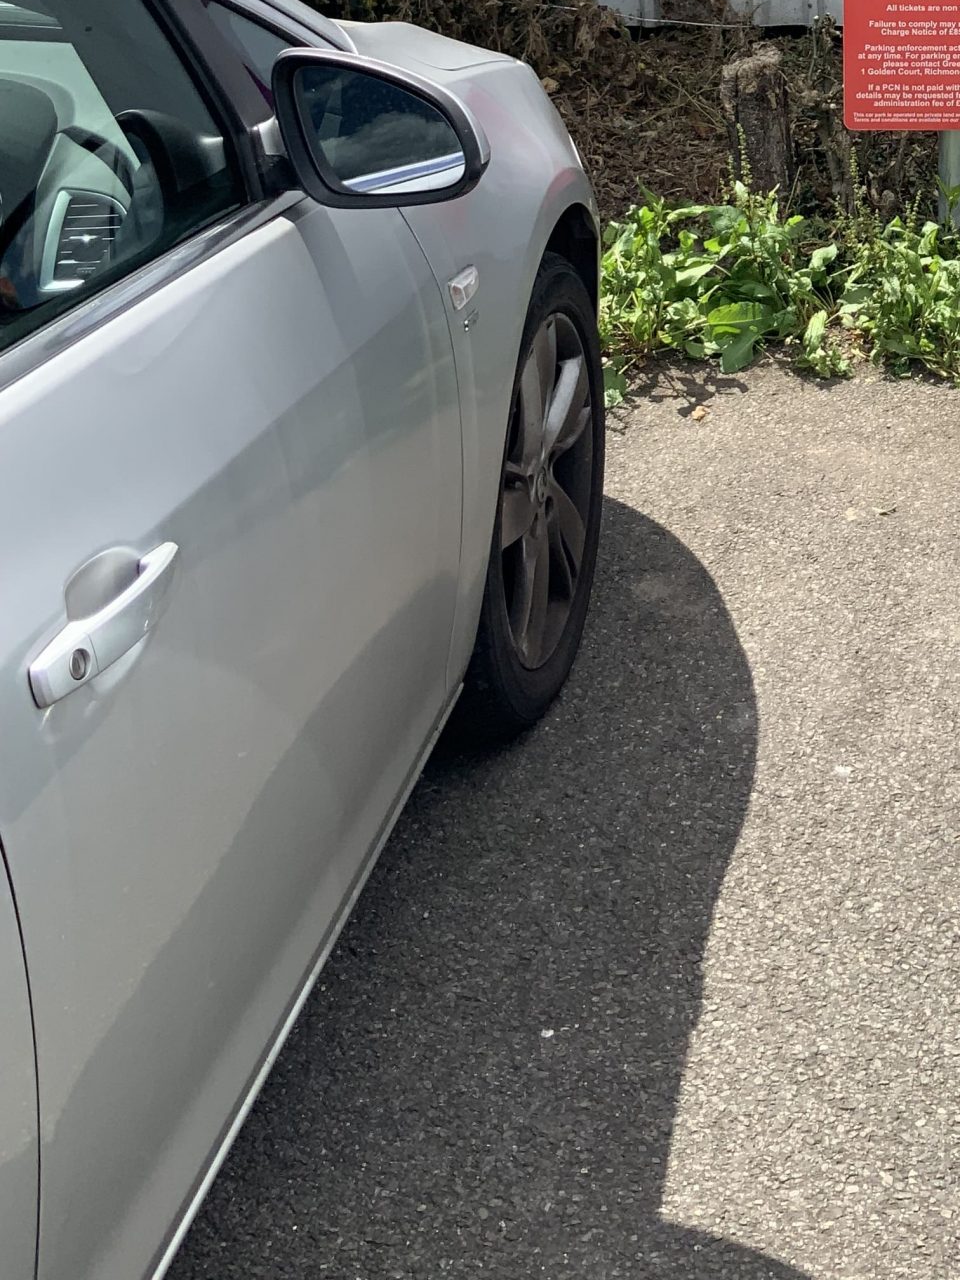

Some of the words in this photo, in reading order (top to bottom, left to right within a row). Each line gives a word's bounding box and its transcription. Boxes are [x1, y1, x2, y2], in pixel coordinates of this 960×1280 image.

[886, 4, 898, 12] All
[898, 4, 926, 12] tickets
[908, 21, 938, 30] comply
[939, 22, 957, 30] may
[880, 28, 910, 37] Charge
[864, 44, 896, 54] Parking
[896, 44, 947, 52] enforcement
[858, 52, 866, 60] at
[905, 52, 919, 60] For
[920, 52, 951, 61] parking
[883, 60, 909, 70] please
[910, 60, 940, 68] contact
[897, 68, 923, 77] Court,
